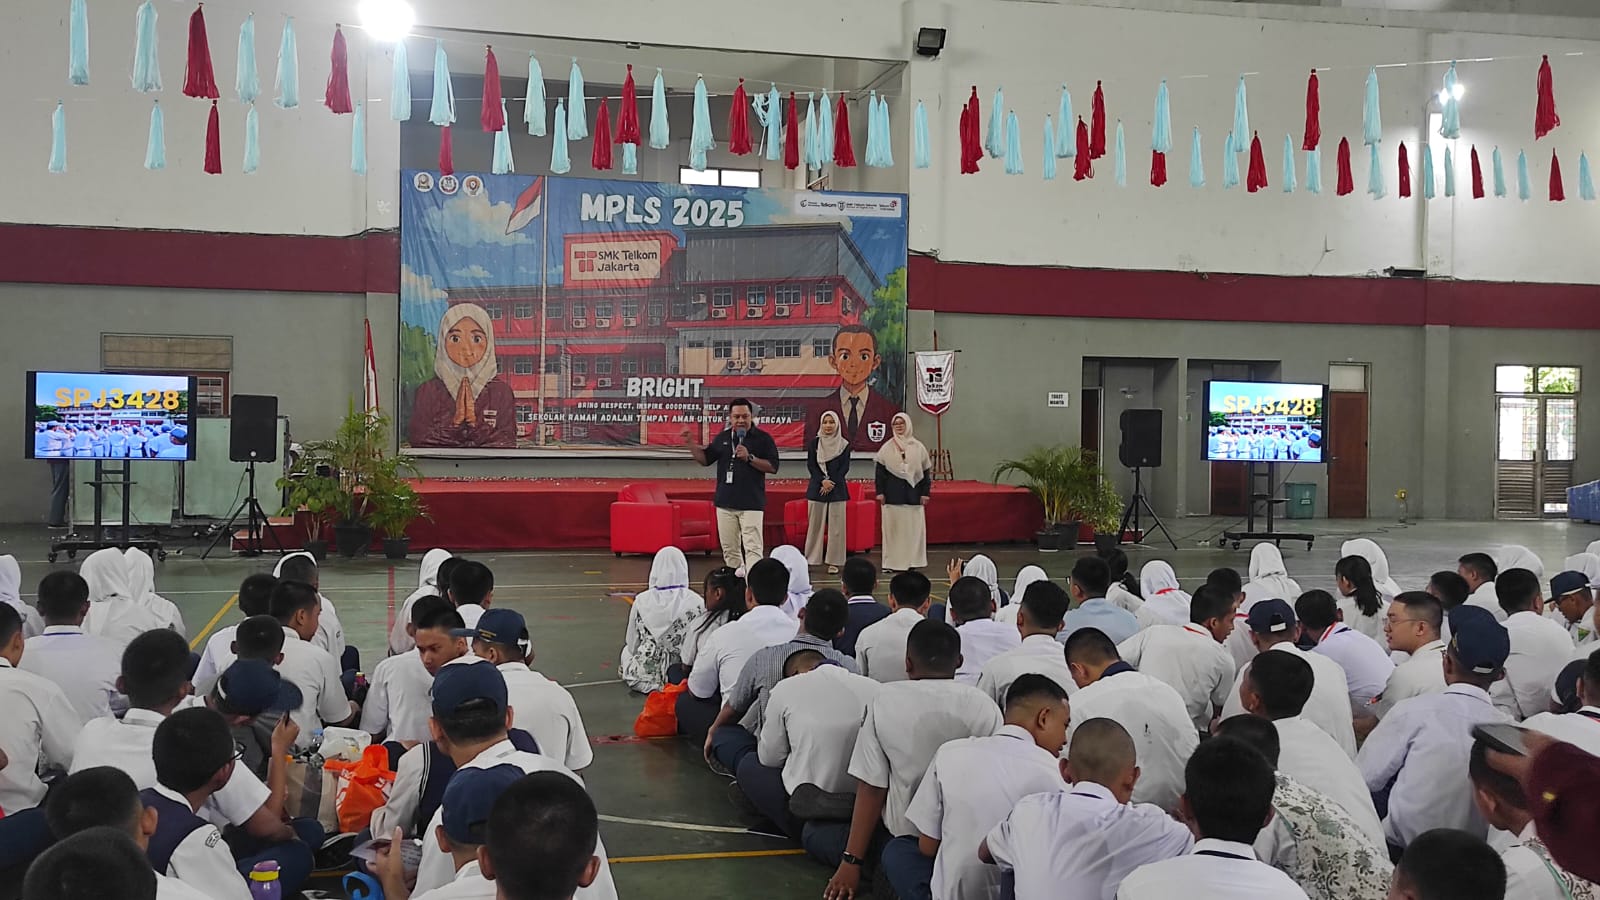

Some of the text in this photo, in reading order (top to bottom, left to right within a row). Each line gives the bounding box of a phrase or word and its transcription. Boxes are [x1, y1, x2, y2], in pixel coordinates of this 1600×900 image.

[580, 193, 744, 228] MPLS 2025
[598, 249, 657, 260] SMK Telkom
[598, 262, 640, 272] Jakarta
[626, 377, 704, 398] BRIGHT
[55, 387, 180, 410] SPJ3428
[601, 402, 634, 411] RESPECT,
[636, 402, 663, 410] INSPIRE
[665, 403, 702, 411] GOODNESS,
[1223, 394, 1316, 416] SPJ3428
[527, 413, 565, 421] SEKOLAH
[568, 413, 598, 422] RAMAH
[600, 414, 634, 422] ADALAH
[636, 414, 668, 423] TEMPAT
[671, 415, 695, 423] AMAN
[697, 415, 723, 423] UNTUK
